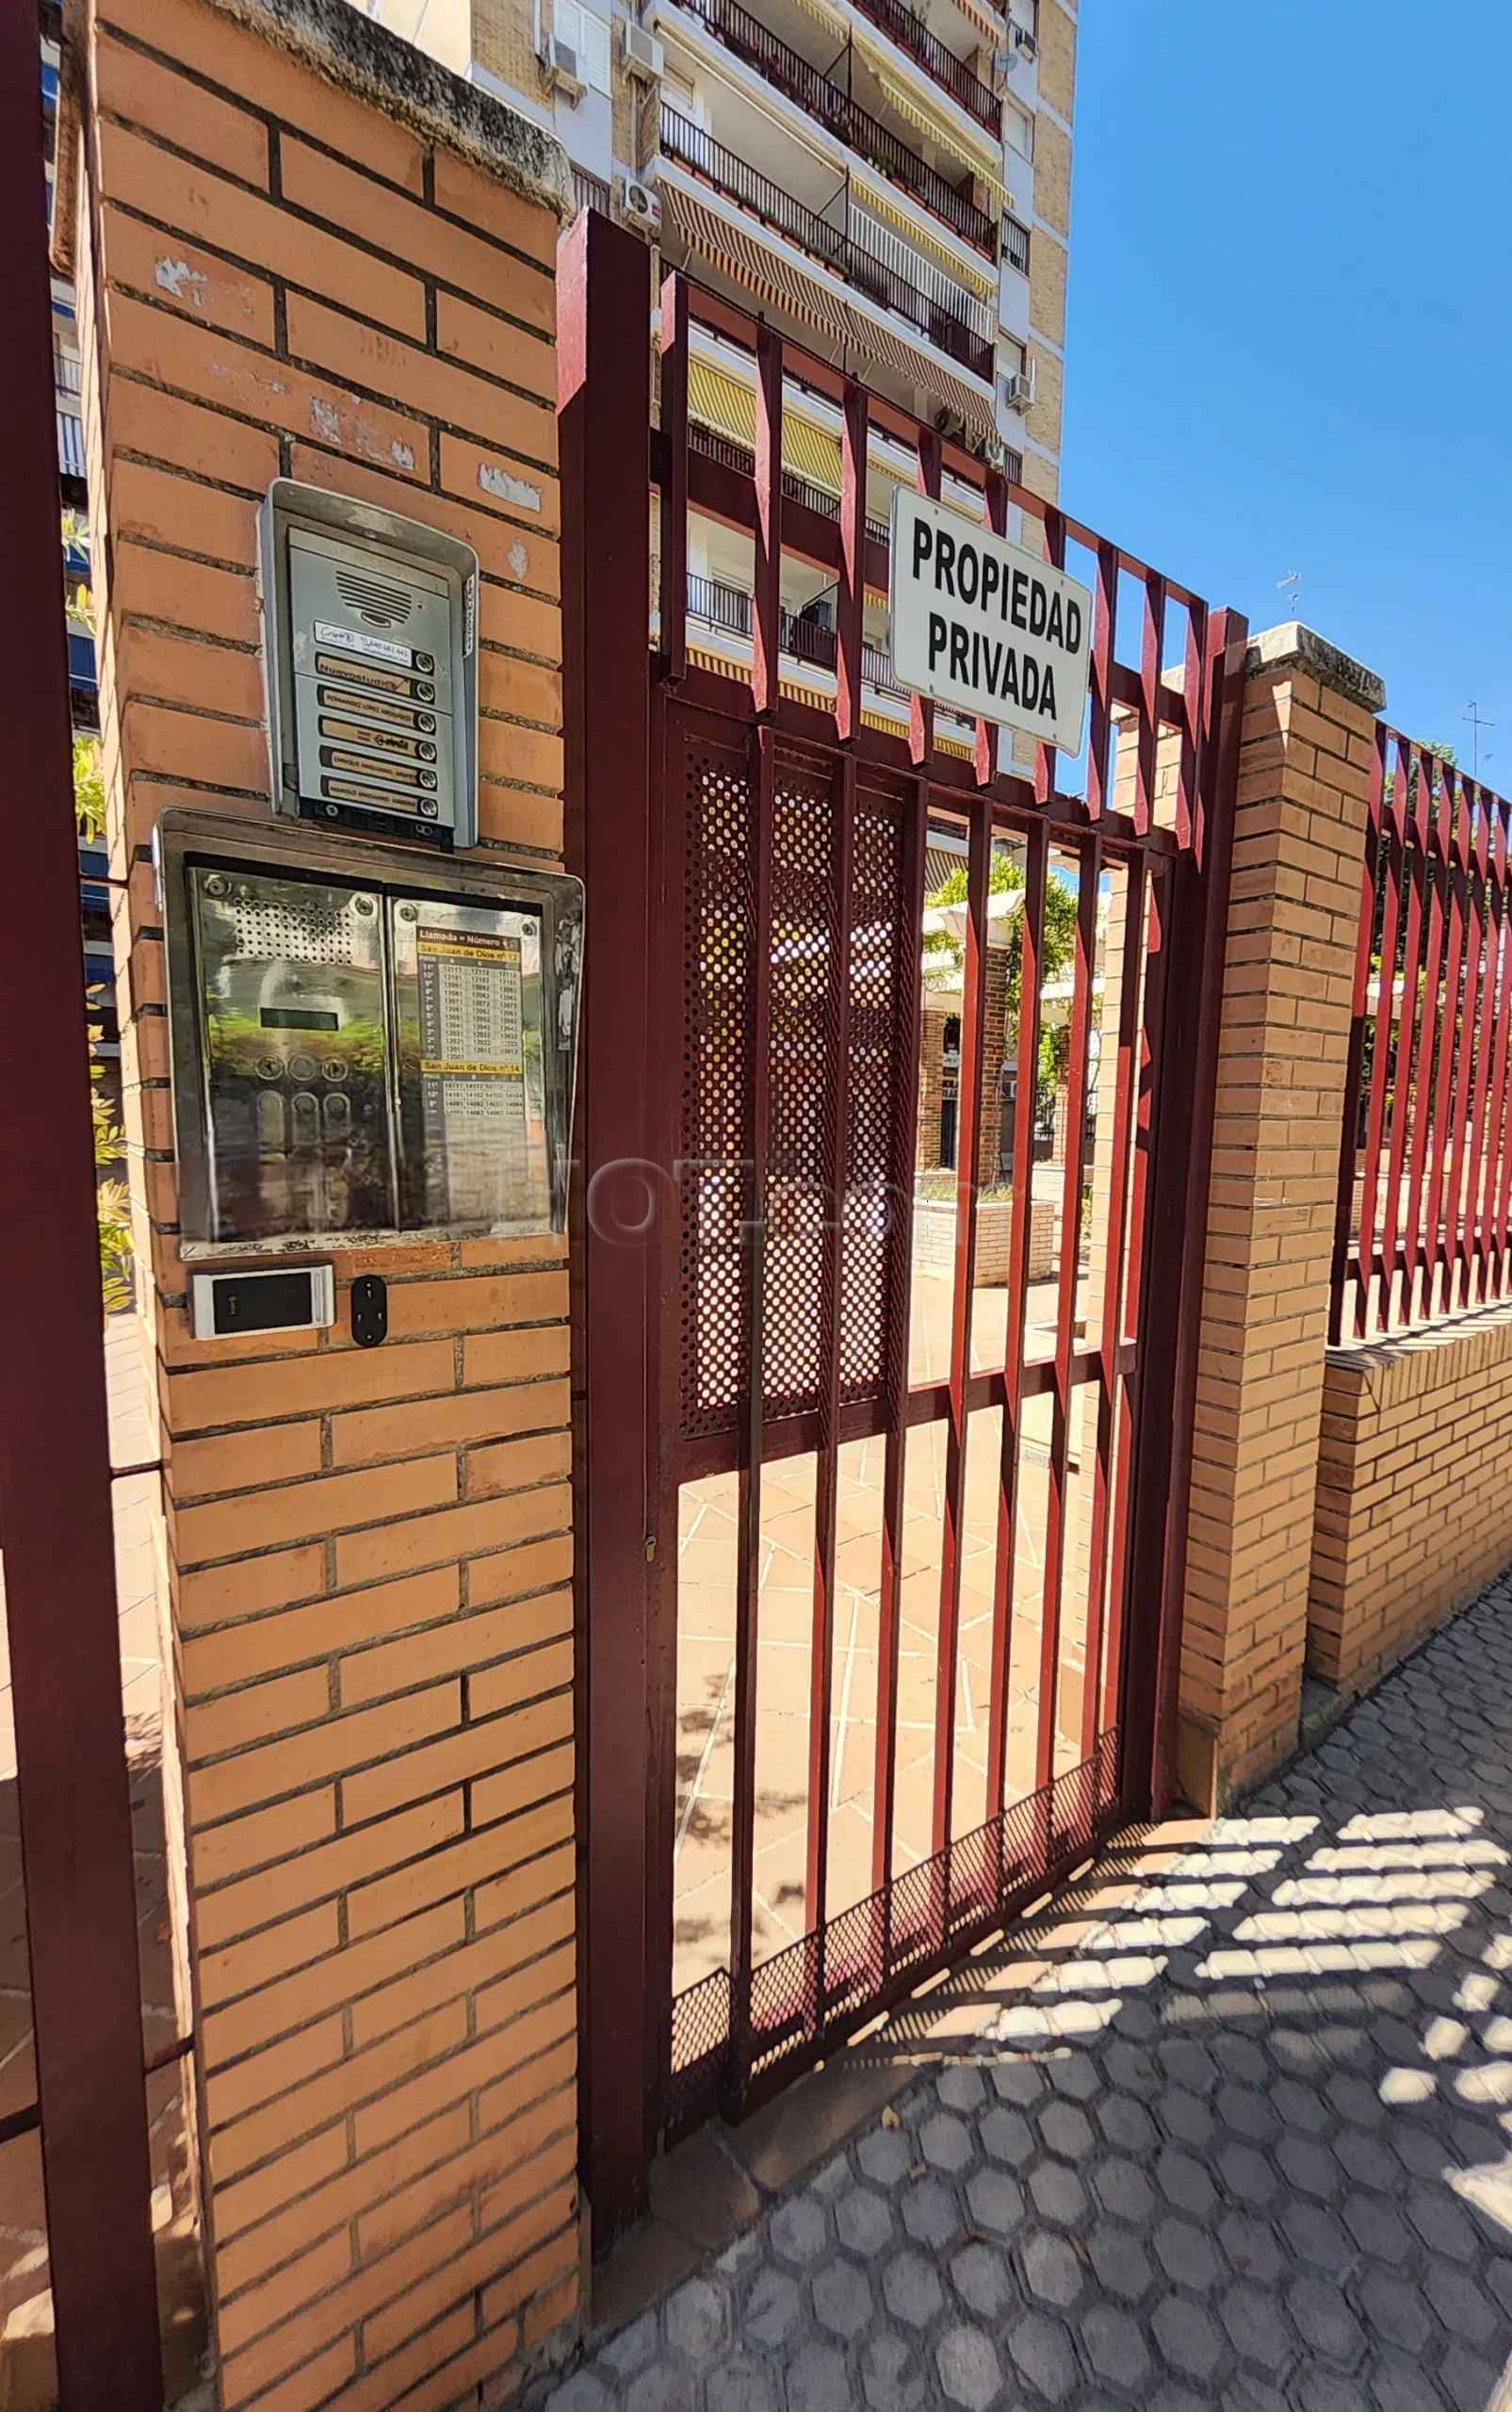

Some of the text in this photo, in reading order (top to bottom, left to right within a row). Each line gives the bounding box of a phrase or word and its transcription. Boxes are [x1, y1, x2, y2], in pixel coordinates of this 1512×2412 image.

[913, 517, 1081, 654] PROPIEDAD
[929, 612, 1057, 720] PRIVADA
[420, 930, 457, 941] Llamada
[467, 935, 500, 946] Número
[421, 944, 437, 952] San
[440, 945, 461, 956] Juan
[477, 950, 495, 959] Dios
